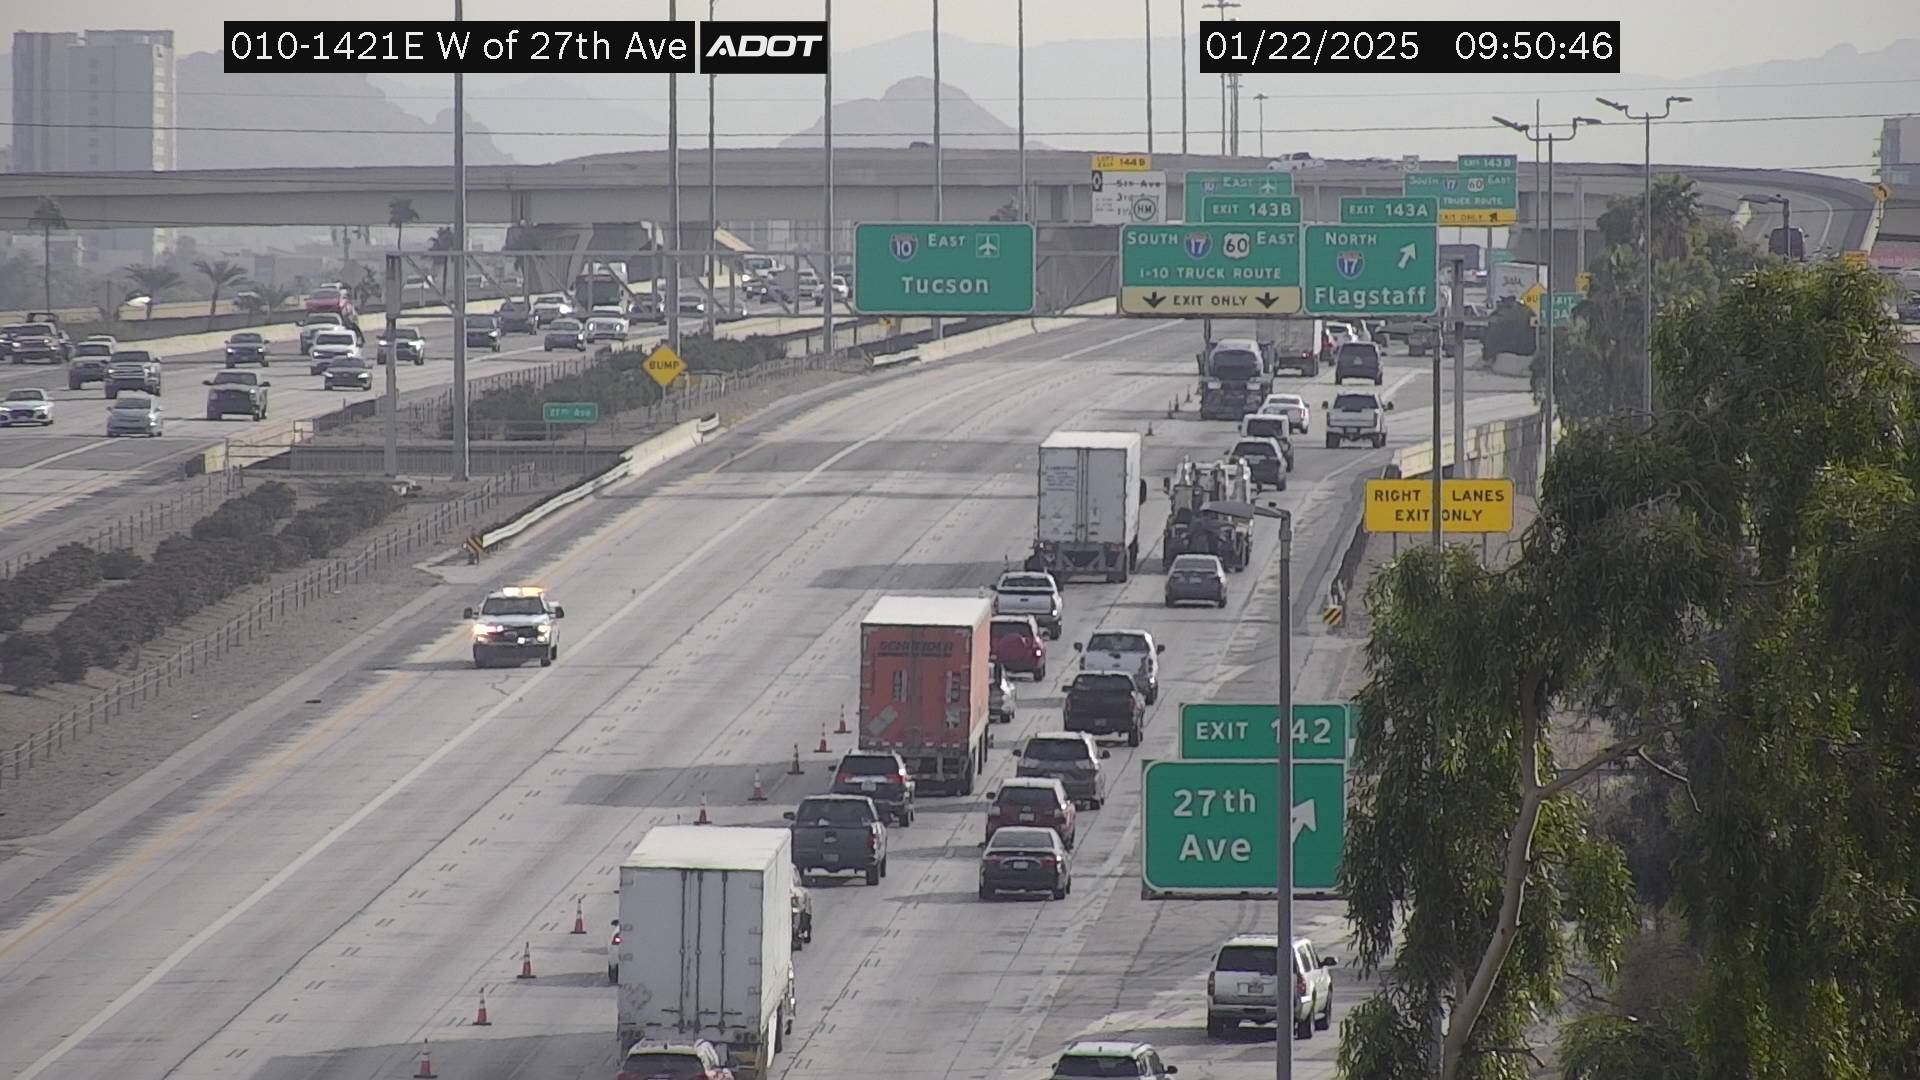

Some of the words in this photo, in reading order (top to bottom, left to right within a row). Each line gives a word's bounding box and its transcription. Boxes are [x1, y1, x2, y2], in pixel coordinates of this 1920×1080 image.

[1212, 204, 1240, 215] EXIT
[1248, 202, 1292, 217] 143B
[1349, 205, 1375, 215] EXIT
[1385, 203, 1428, 217] 143A
[896, 240, 912, 257] 10
[928, 233, 966, 248] EAST
[1127, 231, 1178, 245] SOUTH
[1190, 239, 1206, 255] 17
[1225, 238, 1248, 253] 60
[1256, 231, 1296, 245] EAST
[1325, 231, 1377, 246] NORTH
[1140, 267, 1169, 279] I-10
[1176, 267, 1225, 279] TRUCK
[1233, 267, 1281, 279] ROUTE
[1343, 258, 1358, 275] 17
[902, 276, 990, 295] Tucson
[1173, 295, 1205, 306] EXIT
[1211, 295, 1248, 306] ONLY
[1314, 285, 1427, 310] Flagstaff
[648, 359, 680, 370] BUMP
[1374, 489, 1421, 502] RIGHT
[1452, 489, 1505, 502] LANES
[1395, 508, 1430, 521] EXIT
[1441, 508, 1483, 521] ONLY
[1196, 721, 1249, 740] EXIT
[1270, 717, 1331, 744] 142
[1172, 788, 1256, 817] 27th
[1179, 834, 1251, 861] Ave
